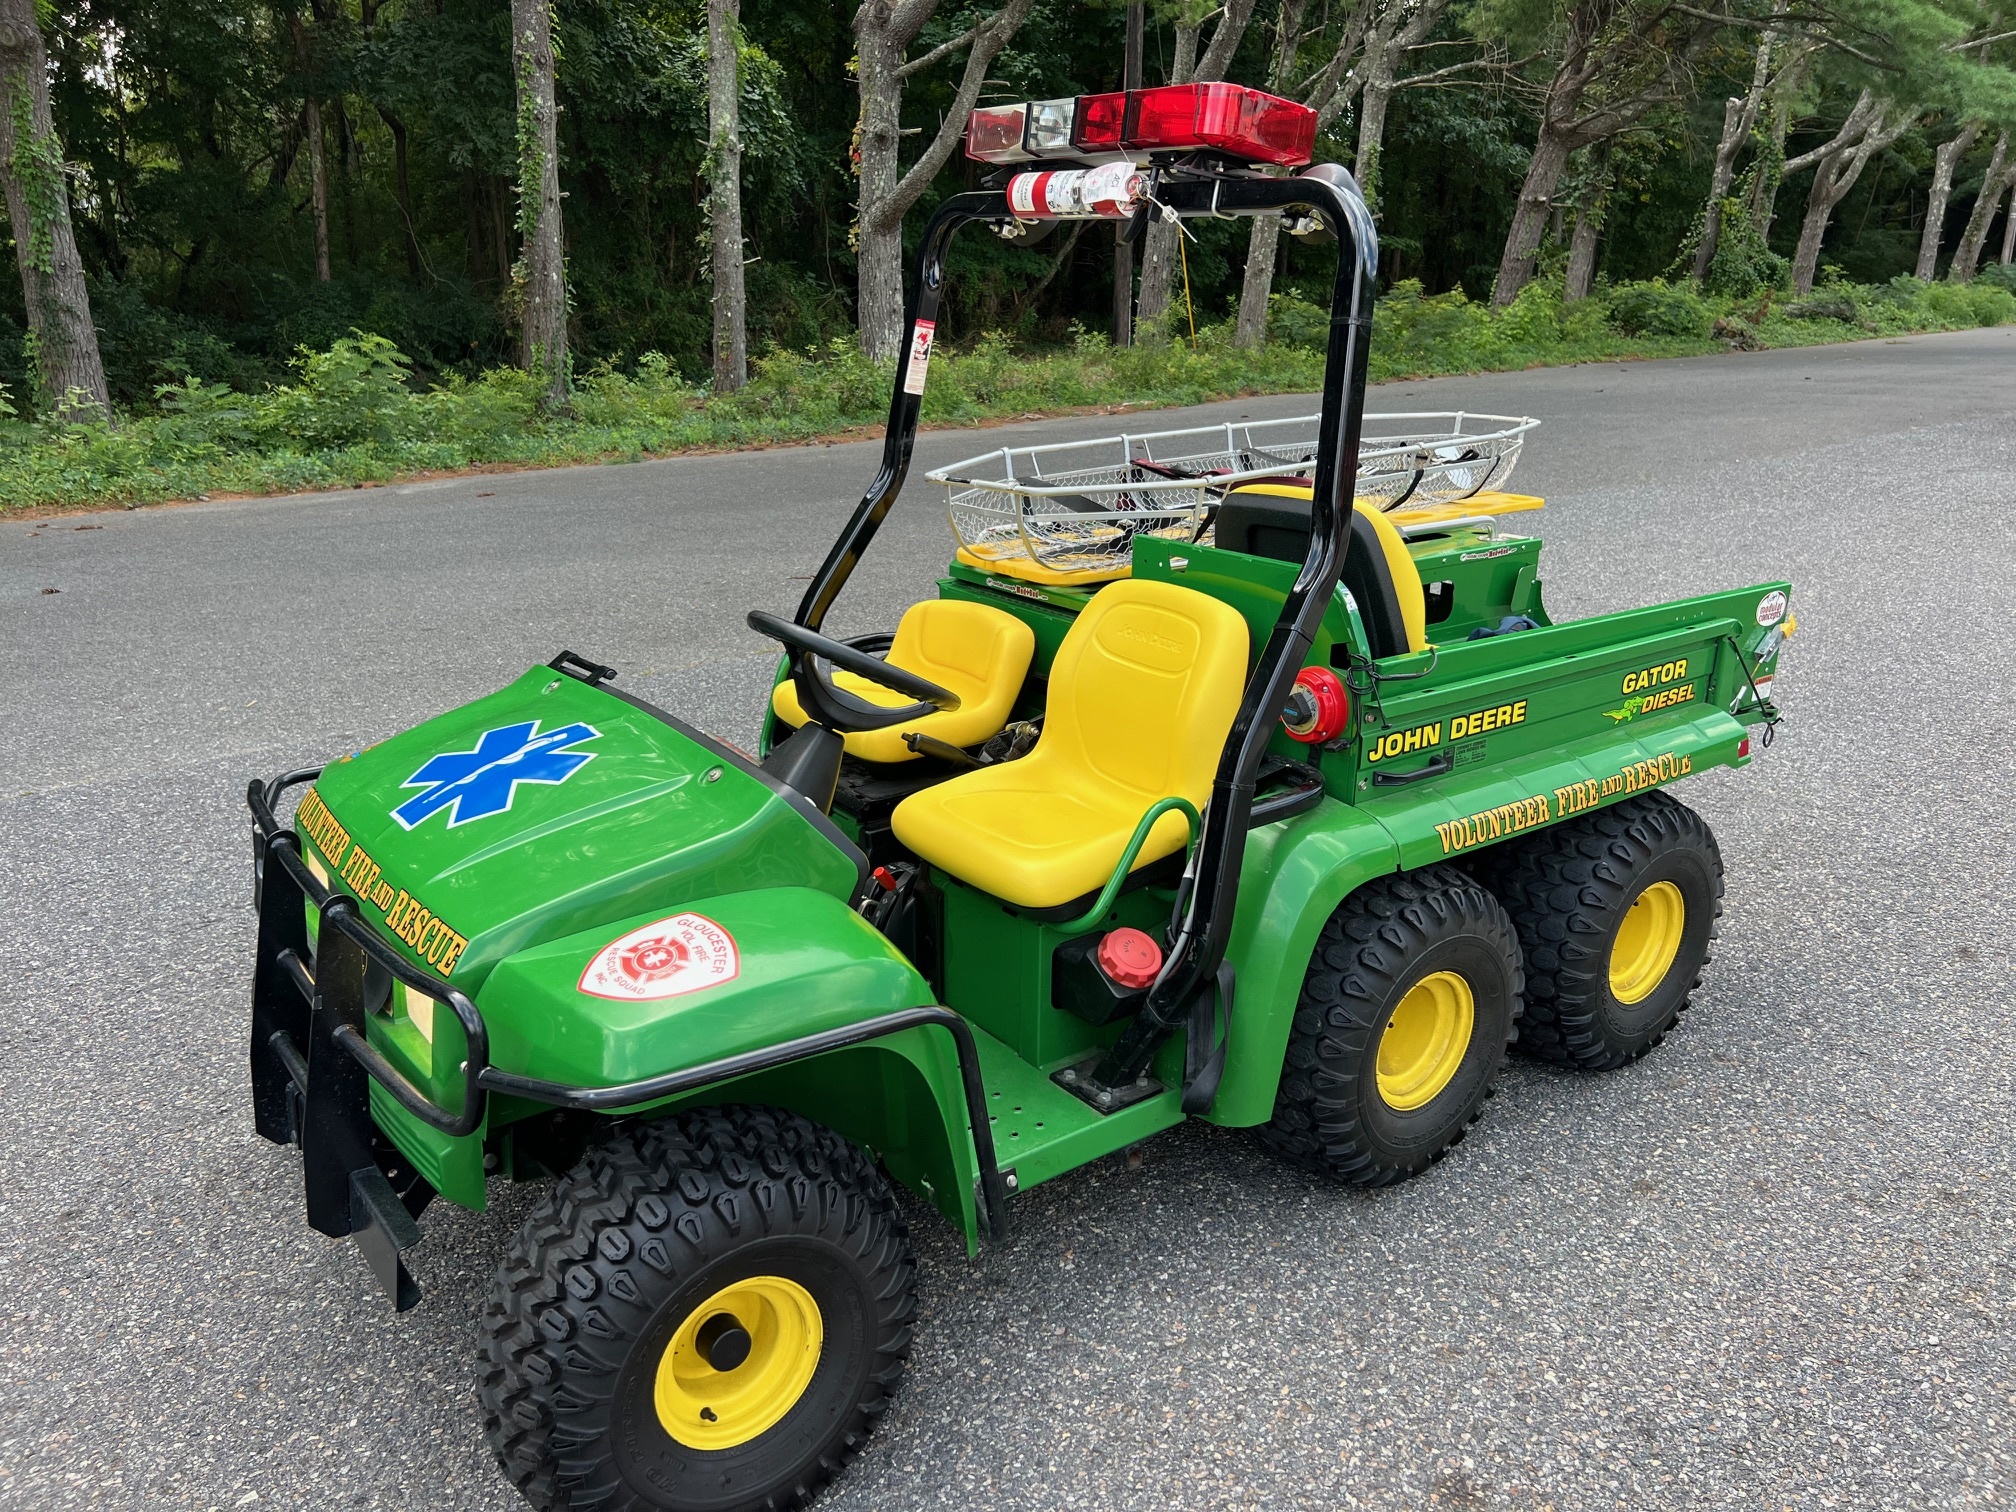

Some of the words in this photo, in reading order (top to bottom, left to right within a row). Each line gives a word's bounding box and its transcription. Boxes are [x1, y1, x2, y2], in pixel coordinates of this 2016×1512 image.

[1758, 610, 1782, 622] concepts
[1760, 603, 1783, 614] modular
[1622, 658, 1688, 695] GATOR
[1640, 683, 1696, 714] DIESEL
[1368, 722, 1442, 763] JOHN
[1449, 699, 1528, 742] DEERE
[1434, 793, 1550, 855] VOLUNTEER
[1553, 778, 1600, 818] FIRE
[1600, 774, 1623, 797] AND
[1620, 751, 1692, 795] RESCUE
[296, 786, 351, 870] VOLUNTEER
[340, 843, 382, 903] FIRE
[369, 878, 396, 913] AND
[384, 887, 470, 978] RESCUE
[607, 947, 621, 976] RESCUE
[677, 918, 727, 975] GLOUCESTER
[692, 944, 711, 964] FIRE
[613, 975, 646, 995] SQUAD
